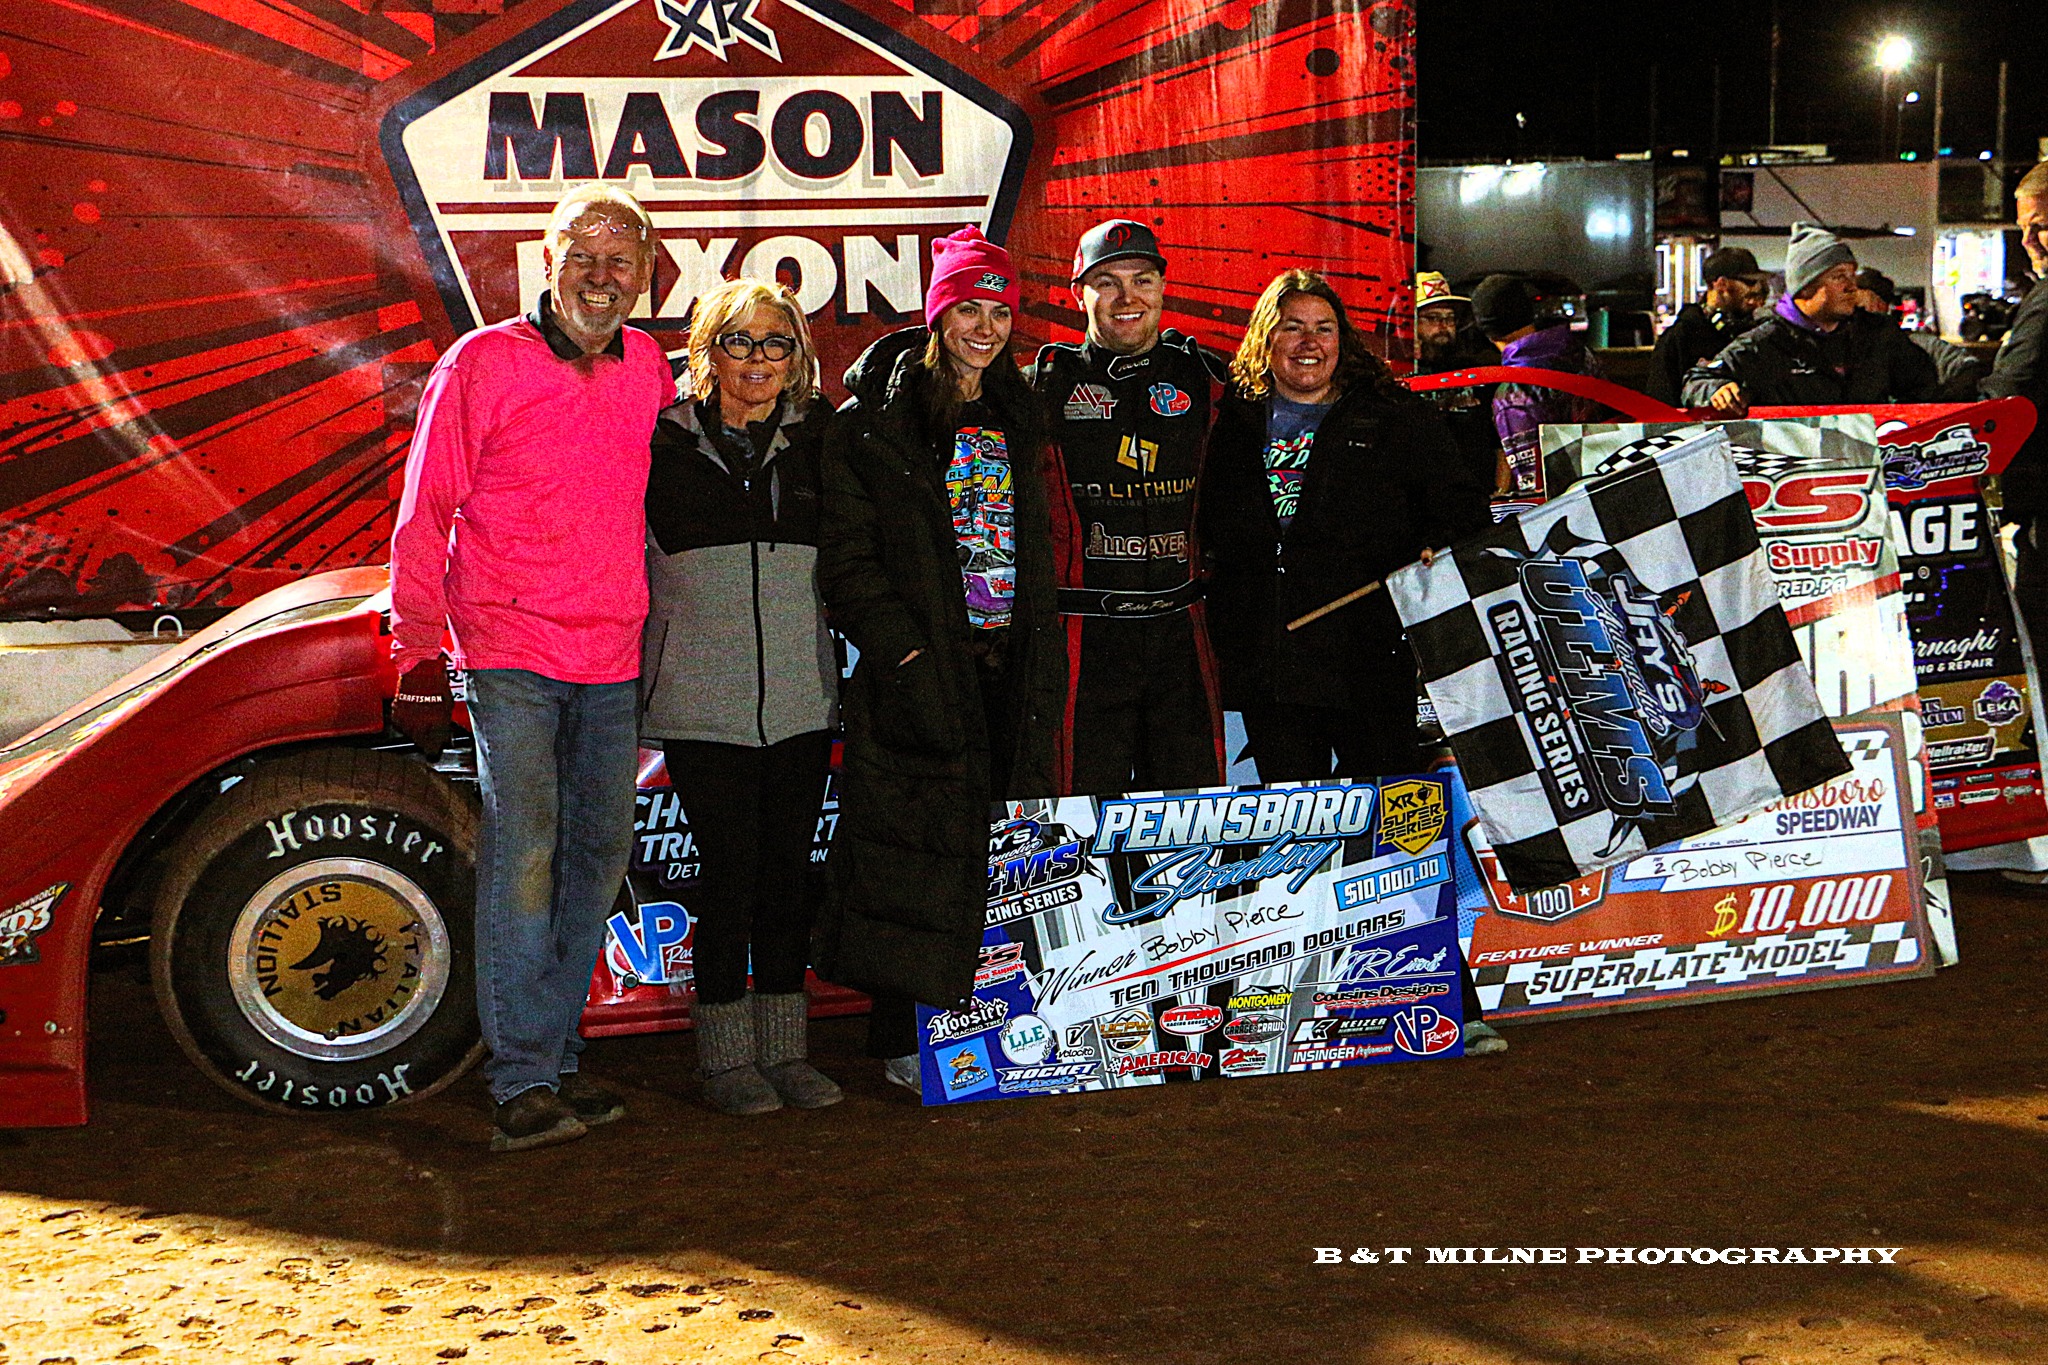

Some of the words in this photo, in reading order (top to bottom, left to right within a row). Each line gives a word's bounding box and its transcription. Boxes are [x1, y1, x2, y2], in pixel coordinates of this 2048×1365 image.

[484, 90, 944, 180] MASON
[1109, 476, 1196, 498] LITHIUM
[1770, 539, 1879, 569] Supply
[1947, 657, 1994, 671] REPAIR
[398, 693, 443, 703] CRAFTSMAN
[1494, 608, 1551, 713] RACING
[1534, 709, 1590, 809] SERIES
[1977, 699, 2019, 716] LEKA
[1383, 803, 1442, 829] SUPER
[1387, 792, 1419, 813] XR
[1095, 787, 1375, 851] PENNSBORO
[1383, 815, 1444, 842] SERIES
[1776, 804, 1883, 836] SPEEDWAY
[266, 811, 443, 863] Hoosier
[1344, 857, 1440, 905] $10,000.00
[1671, 859, 1737, 883] Bobby
[1745, 851, 1823, 871] Pierce
[985, 903, 1022, 925] CING
[1025, 885, 1078, 913] SERIES
[1533, 888, 1567, 915] 100
[257, 882, 342, 997] STALLION
[606, 901, 690, 983] VP
[1475, 943, 1574, 965] FEATURE
[1578, 934, 1665, 951] WINNER
[1020, 949, 1137, 1011] Winner
[1141, 924, 1220, 963] Bobby
[1225, 901, 1305, 934] Pierce
[1109, 979, 1159, 1006] TEN
[1168, 940, 1295, 988] THOUSAND
[1303, 909, 1405, 951] DOLLARS
[1529, 962, 1635, 996] SUPER
[1646, 950, 1732, 984] LATE
[1740, 939, 1847, 972] MODEL
[337, 919, 420, 1036] ITALIAN
[1228, 992, 1293, 1009] MONTGOMERY
[1312, 987, 1379, 1004] Cousins
[1379, 983, 1449, 998] Designs
[932, 1003, 1004, 1040] Hoosier
[953, 1024, 984, 1038] RACING
[1340, 1018, 1388, 1029] KEIZER
[1394, 1006, 1440, 1053] VP
[1427, 1028, 1457, 1047] Racing
[1008, 1025, 1046, 1051] LLE
[1118, 1051, 1212, 1076] AMERICAN
[1293, 1045, 1355, 1064] INSINGER
[235, 1059, 414, 1108] Hoosier
[1006, 1063, 1096, 1081] ROCKET
